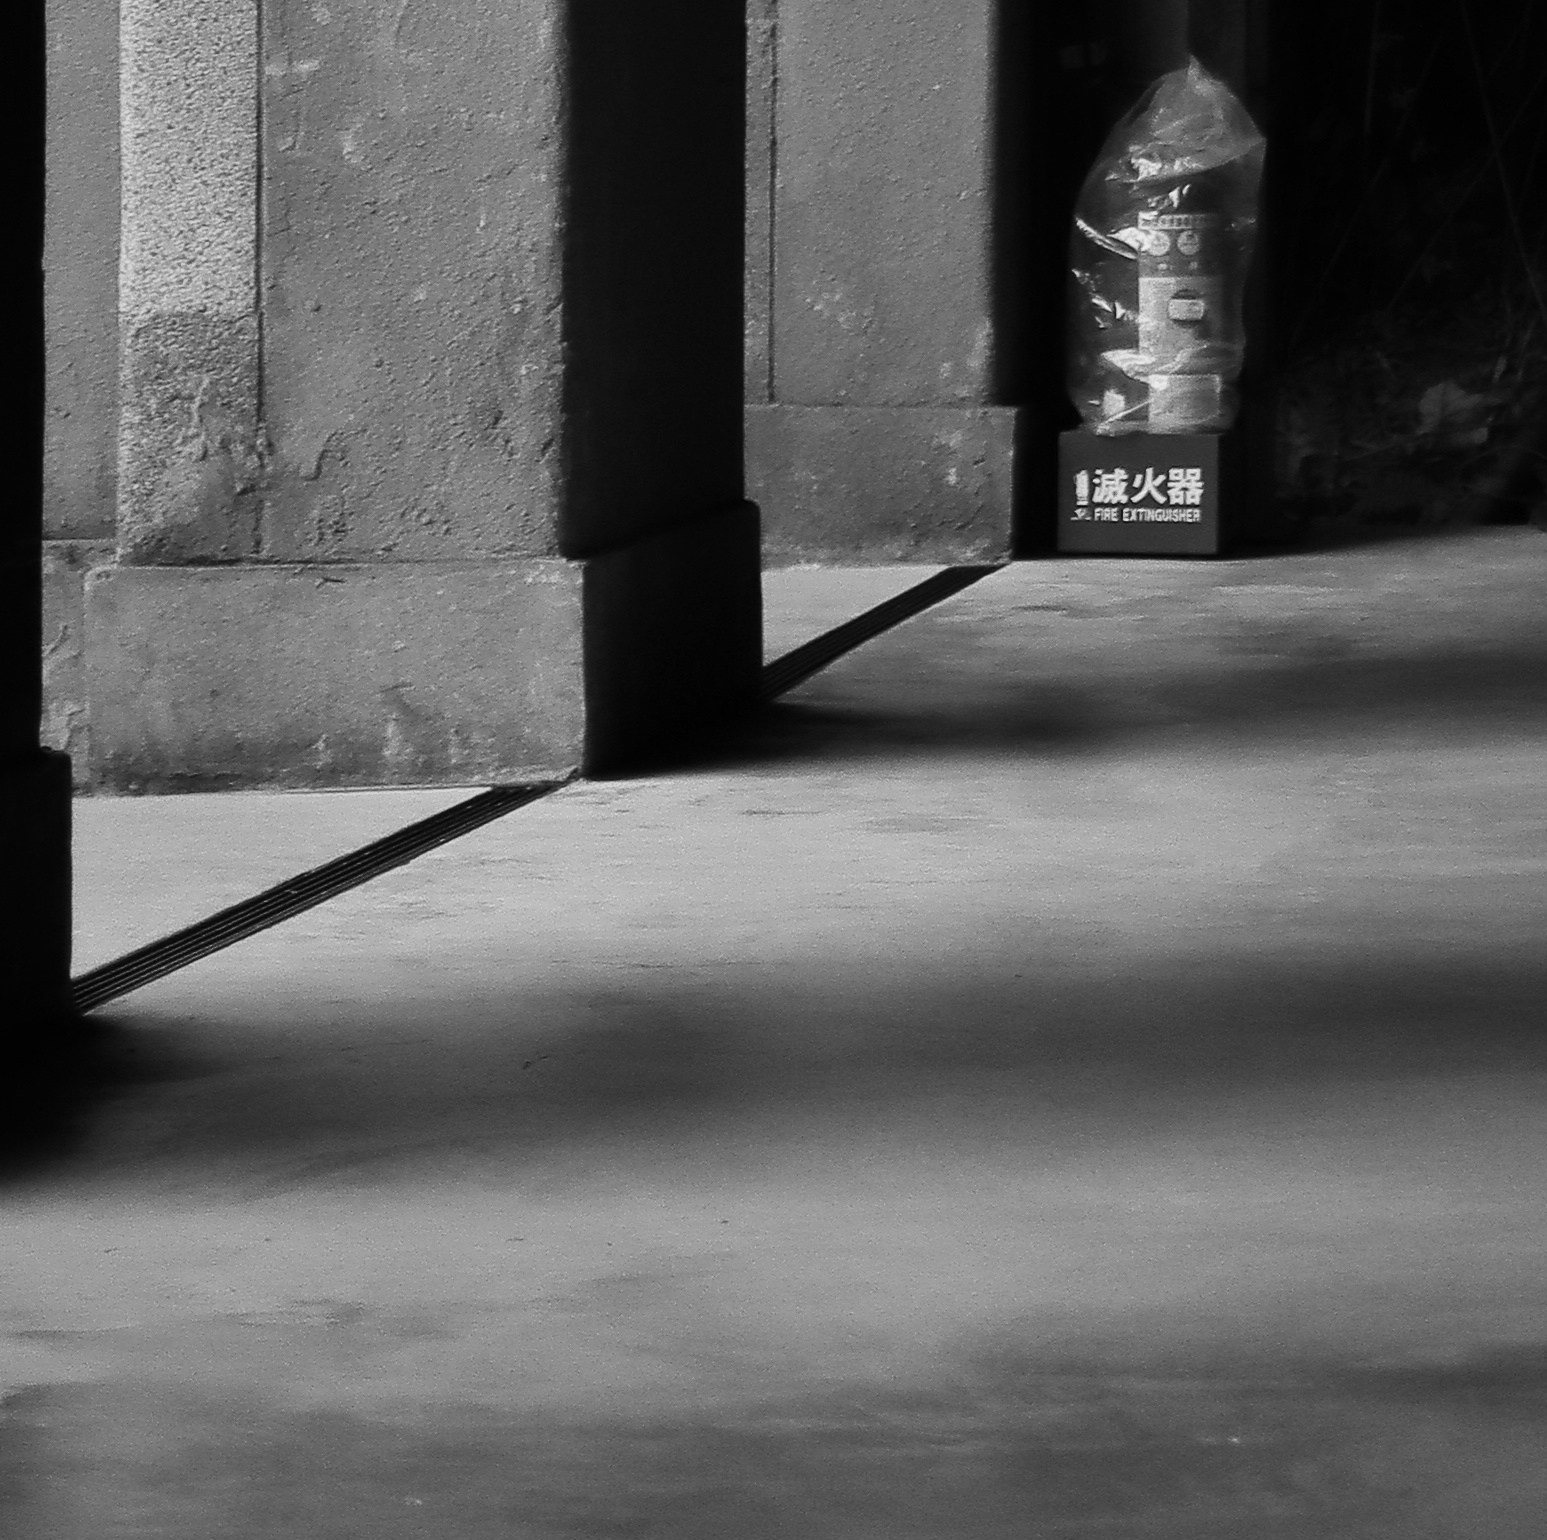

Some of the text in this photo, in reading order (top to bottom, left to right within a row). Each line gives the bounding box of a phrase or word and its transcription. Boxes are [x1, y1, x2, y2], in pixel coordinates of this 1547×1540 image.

[1092, 466, 1205, 506] 滅火器
[1094, 507, 1201, 523] FIRE EXTINGUISHER
